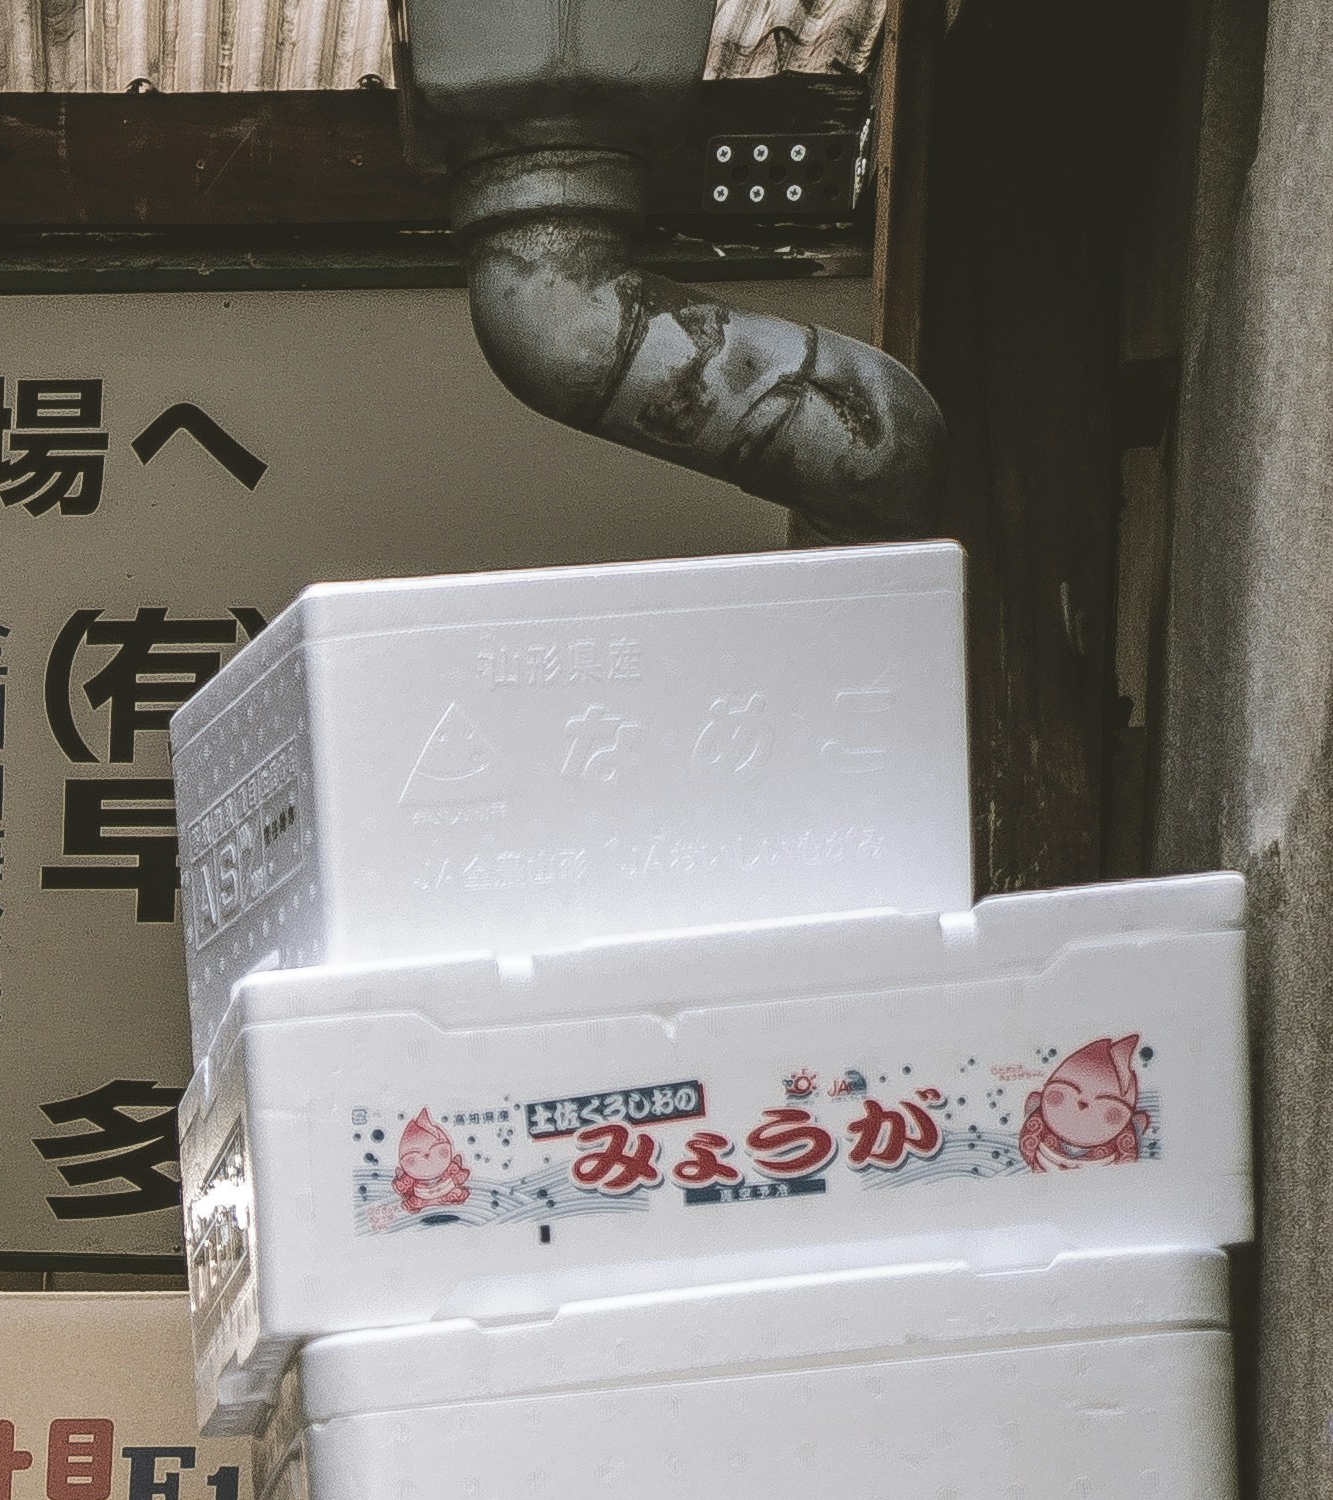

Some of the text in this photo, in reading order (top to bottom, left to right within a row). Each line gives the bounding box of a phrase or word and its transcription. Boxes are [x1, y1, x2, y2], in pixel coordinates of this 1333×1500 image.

[530, 1086, 699, 1132] 土佐くろしおの
[573, 1088, 945, 1190] みょうが
